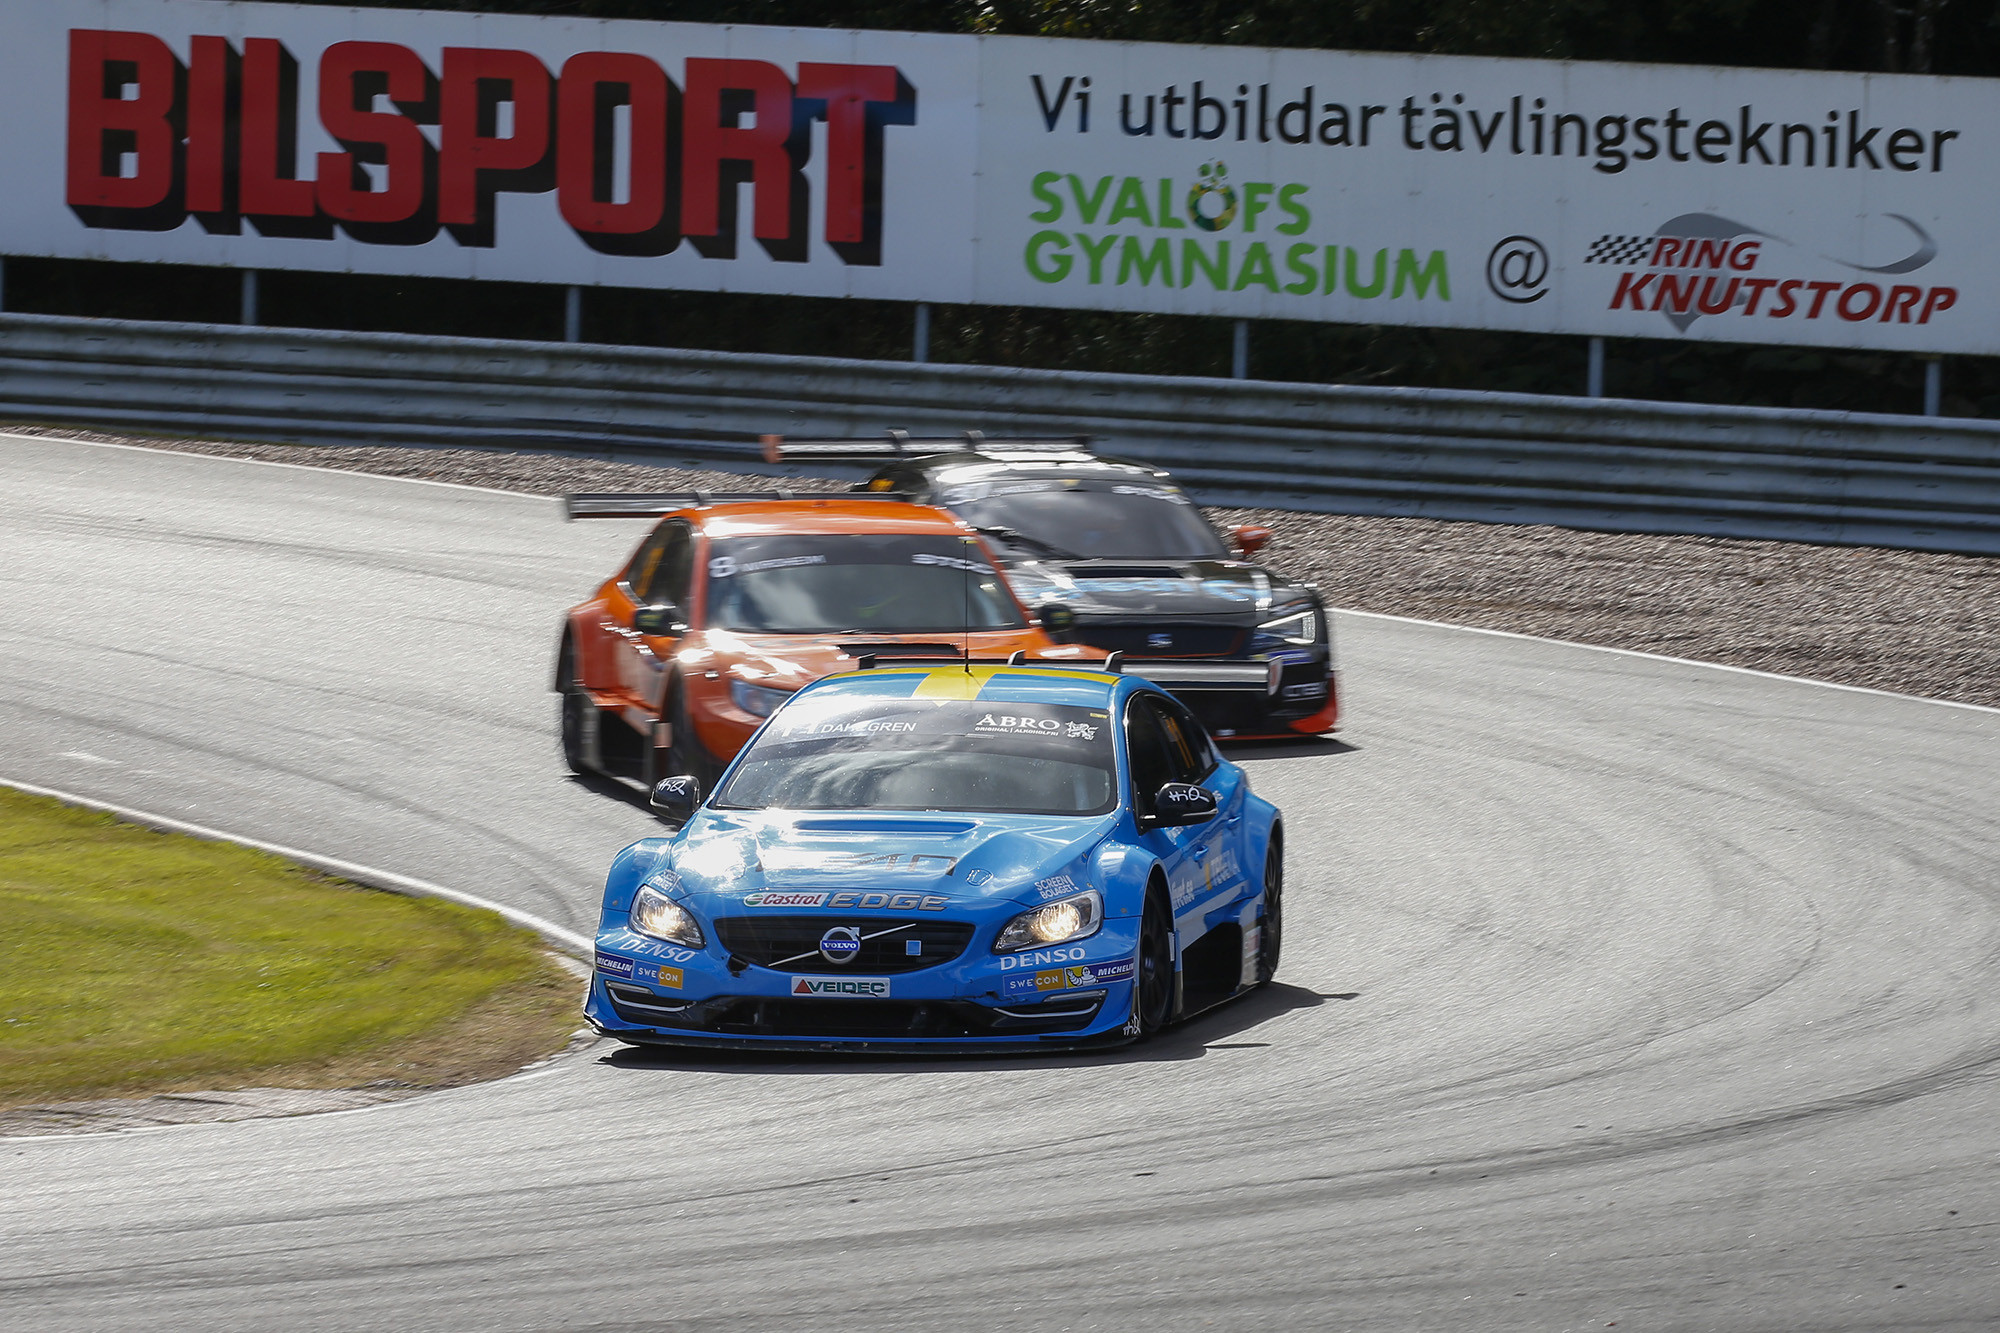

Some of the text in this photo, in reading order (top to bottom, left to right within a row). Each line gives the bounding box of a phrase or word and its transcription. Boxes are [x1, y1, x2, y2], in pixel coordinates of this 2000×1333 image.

[1029, 74, 1961, 174] Vi utbildar tävlingstekniker
[66, 28, 916, 266] BILSPORT
[1029, 159, 1311, 235] SVALÖFS
[1025, 229, 1452, 301] GYMNASIUM
[1486, 234, 1550, 303] @
[1649, 237, 1763, 271] RING
[1608, 271, 1958, 325] KNUTSTORP
[976, 713, 1060, 730] ÅBRO
[762, 892, 951, 912] Castrol EDGE
[1040, 884, 1073, 900] BOLAGET
[618, 939, 697, 963] DENSO
[1000, 947, 1086, 971] DENSO
[807, 981, 886, 993] VEIDEC
